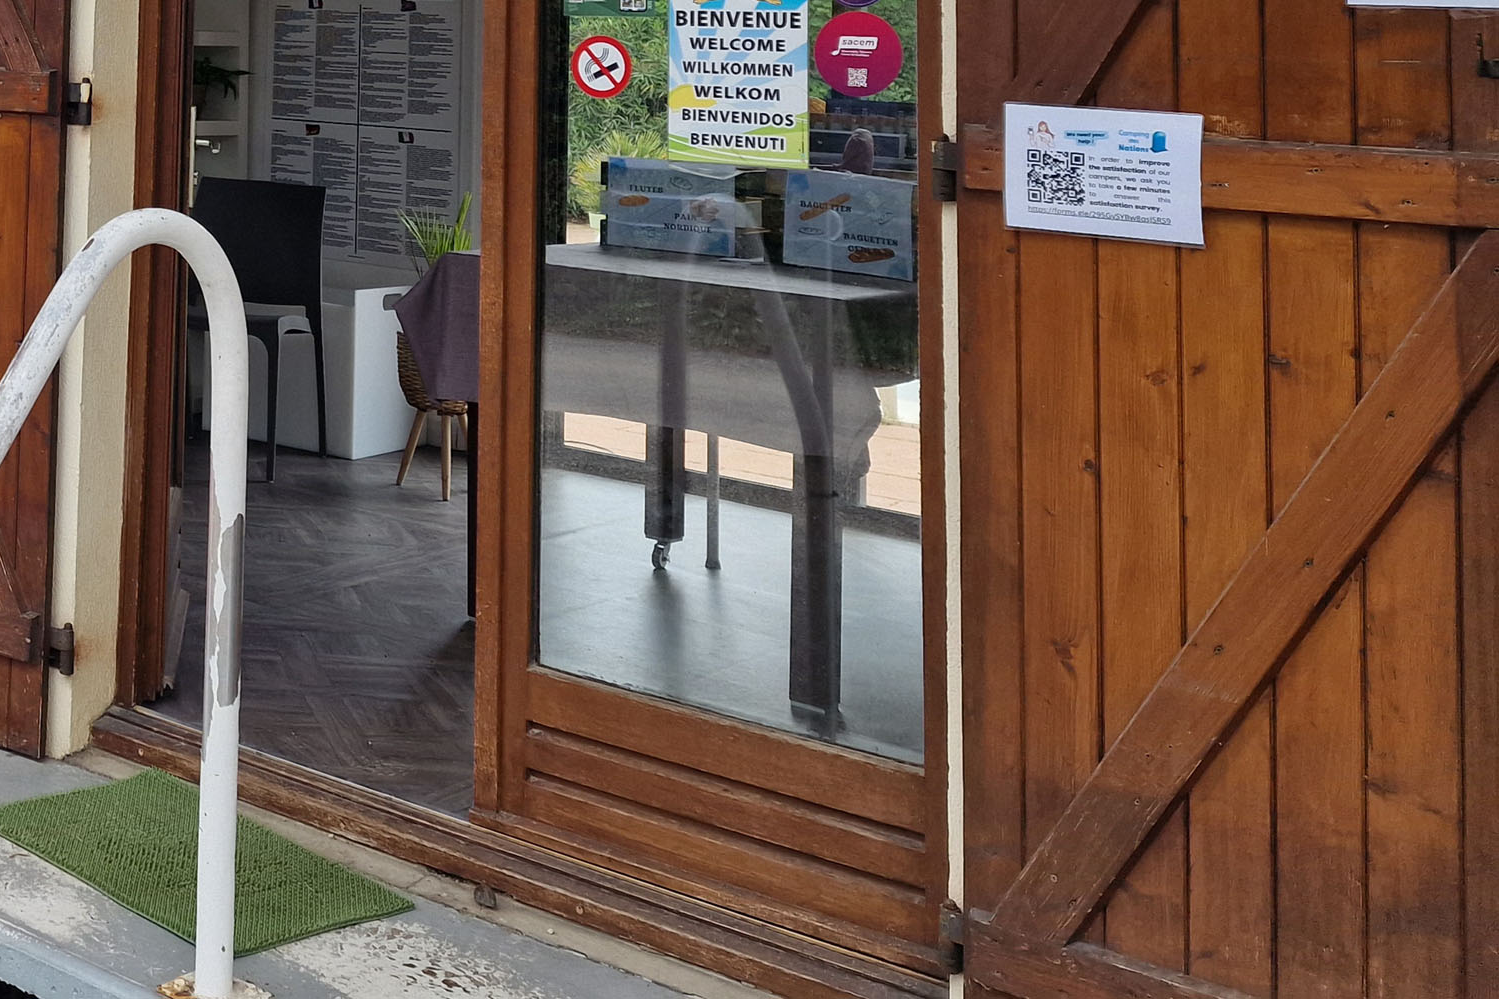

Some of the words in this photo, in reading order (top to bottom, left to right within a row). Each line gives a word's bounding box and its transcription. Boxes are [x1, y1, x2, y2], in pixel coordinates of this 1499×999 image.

[676, 10, 801, 29] BIENVENUE
[690, 37, 786, 52] WELCOME
[842, 39, 875, 47] sacem
[683, 61, 793, 77] WILLKOMMEN
[694, 85, 781, 102] WELKOM
[682, 108, 794, 127] BIENVENIDOS
[1118, 129, 1150, 139] Camping
[690, 133, 785, 151] BENVENUTI
[1118, 144, 1149, 153] Nations
[1138, 159, 1171, 167] improve
[1102, 165, 1147, 175] satisfaction
[1089, 200, 1133, 209] satisfaction
[1134, 204, 1163, 213] survey.
[663, 222, 712, 233] NORDIQUE
[843, 232, 898, 246] BAGUETTES
